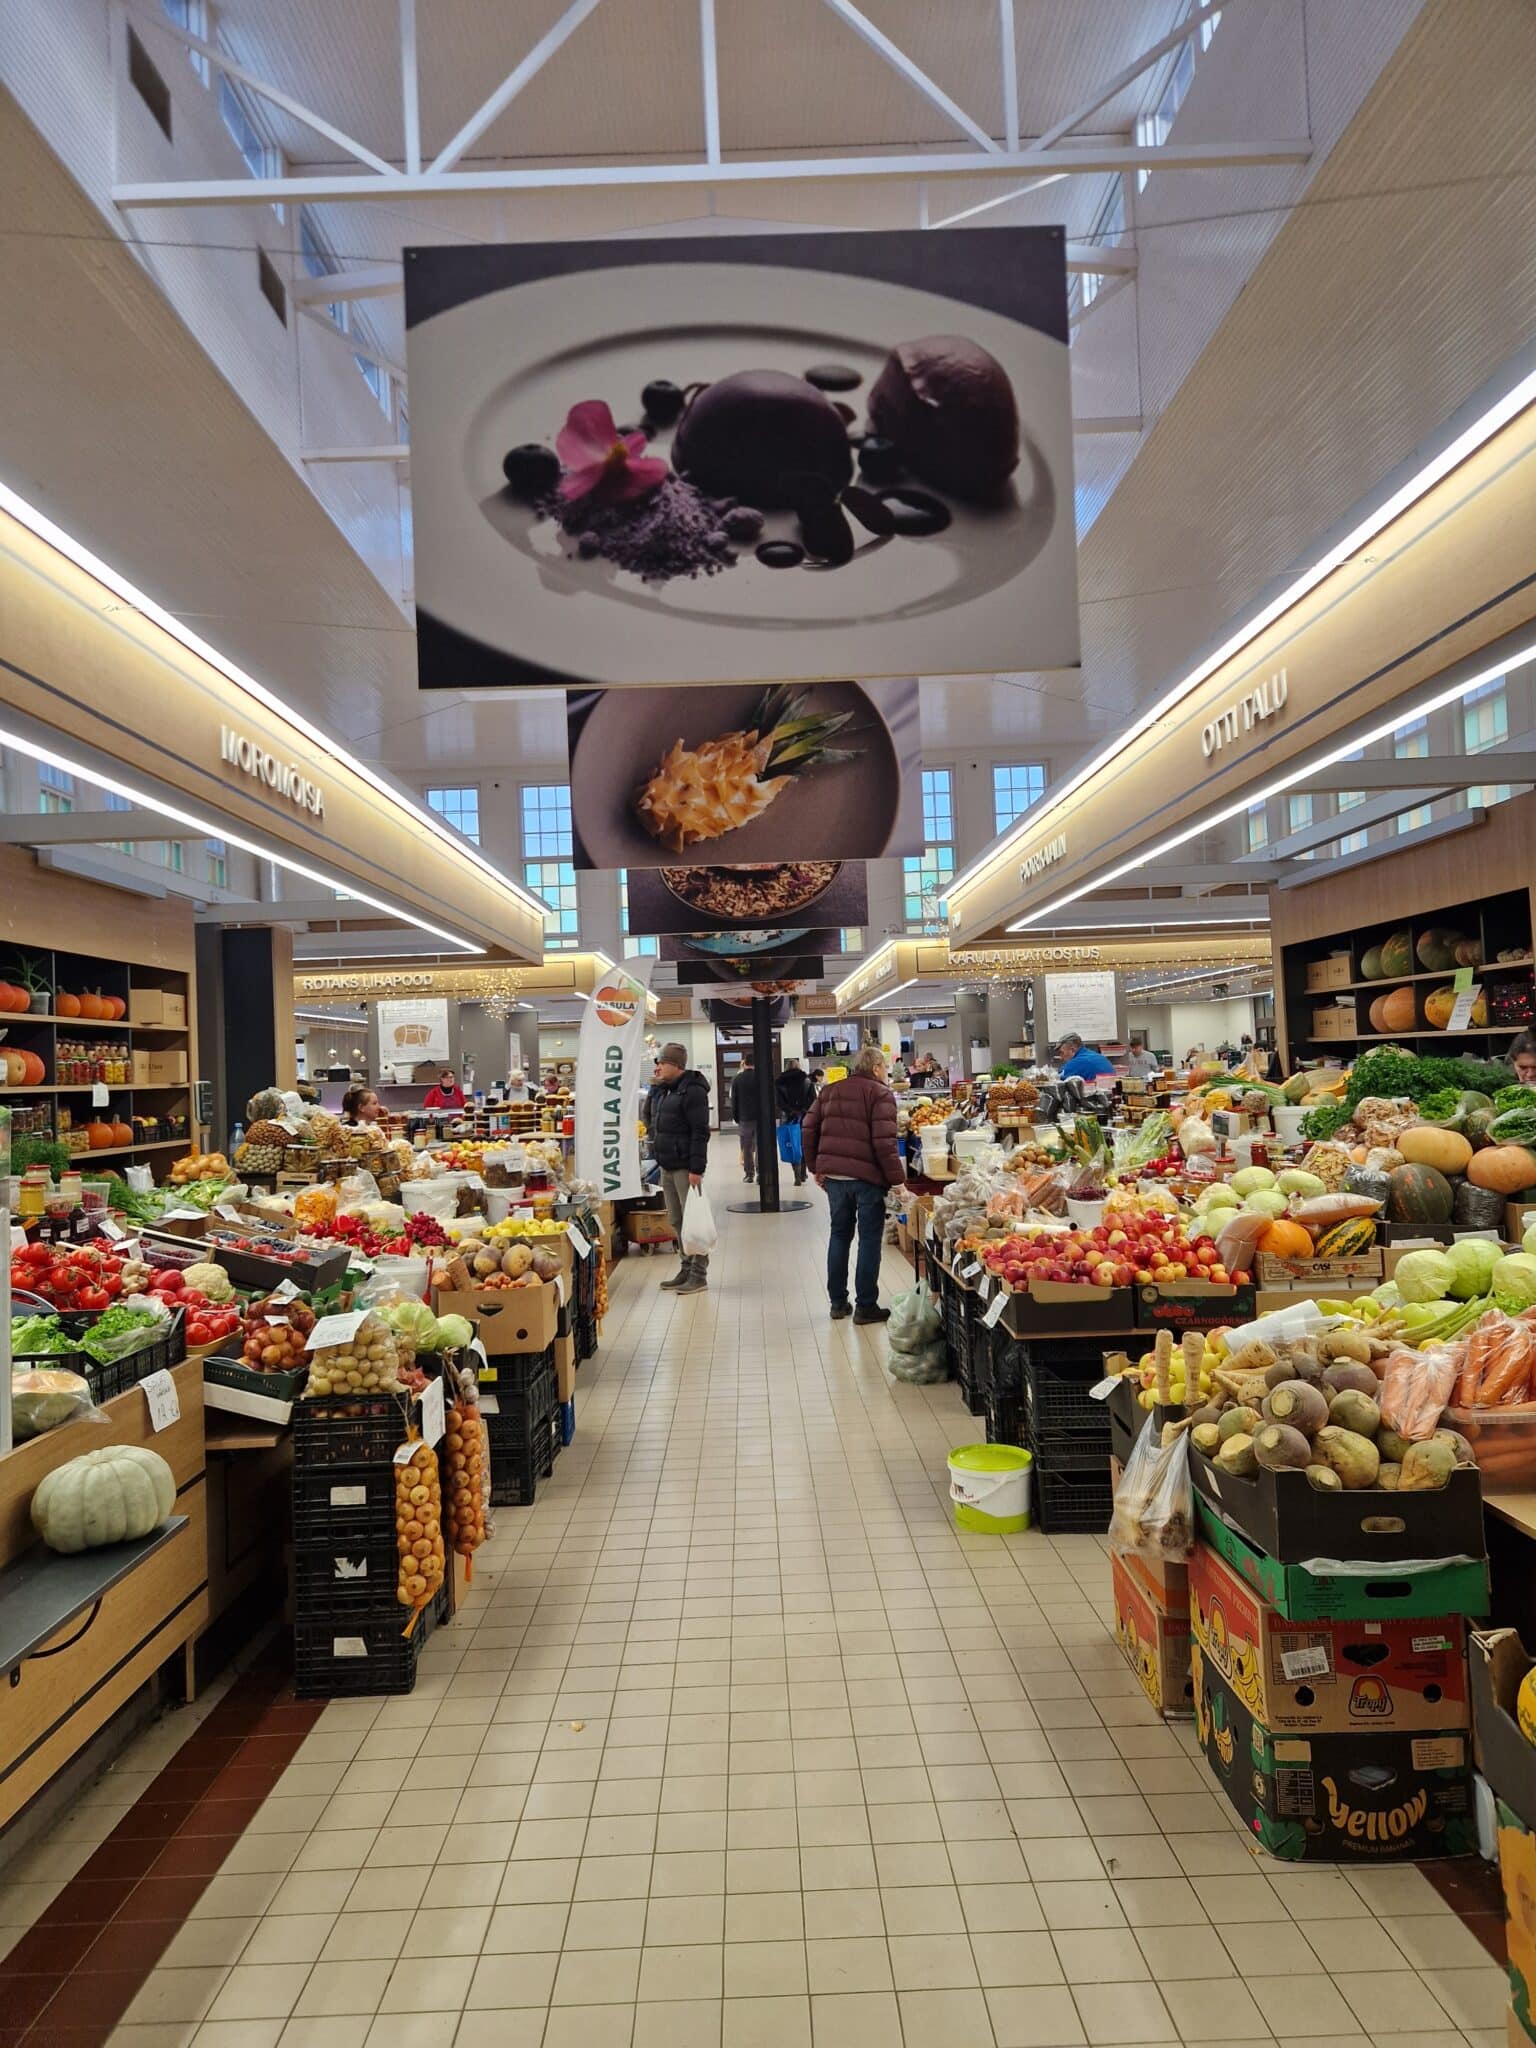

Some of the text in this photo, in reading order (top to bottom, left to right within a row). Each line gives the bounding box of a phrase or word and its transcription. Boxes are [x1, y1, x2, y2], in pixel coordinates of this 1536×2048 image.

[1202, 668, 1287, 757] OTTI TALU
[303, 976, 359, 990] ROTAKS
[603, 1045, 623, 1194] VASULA AED
